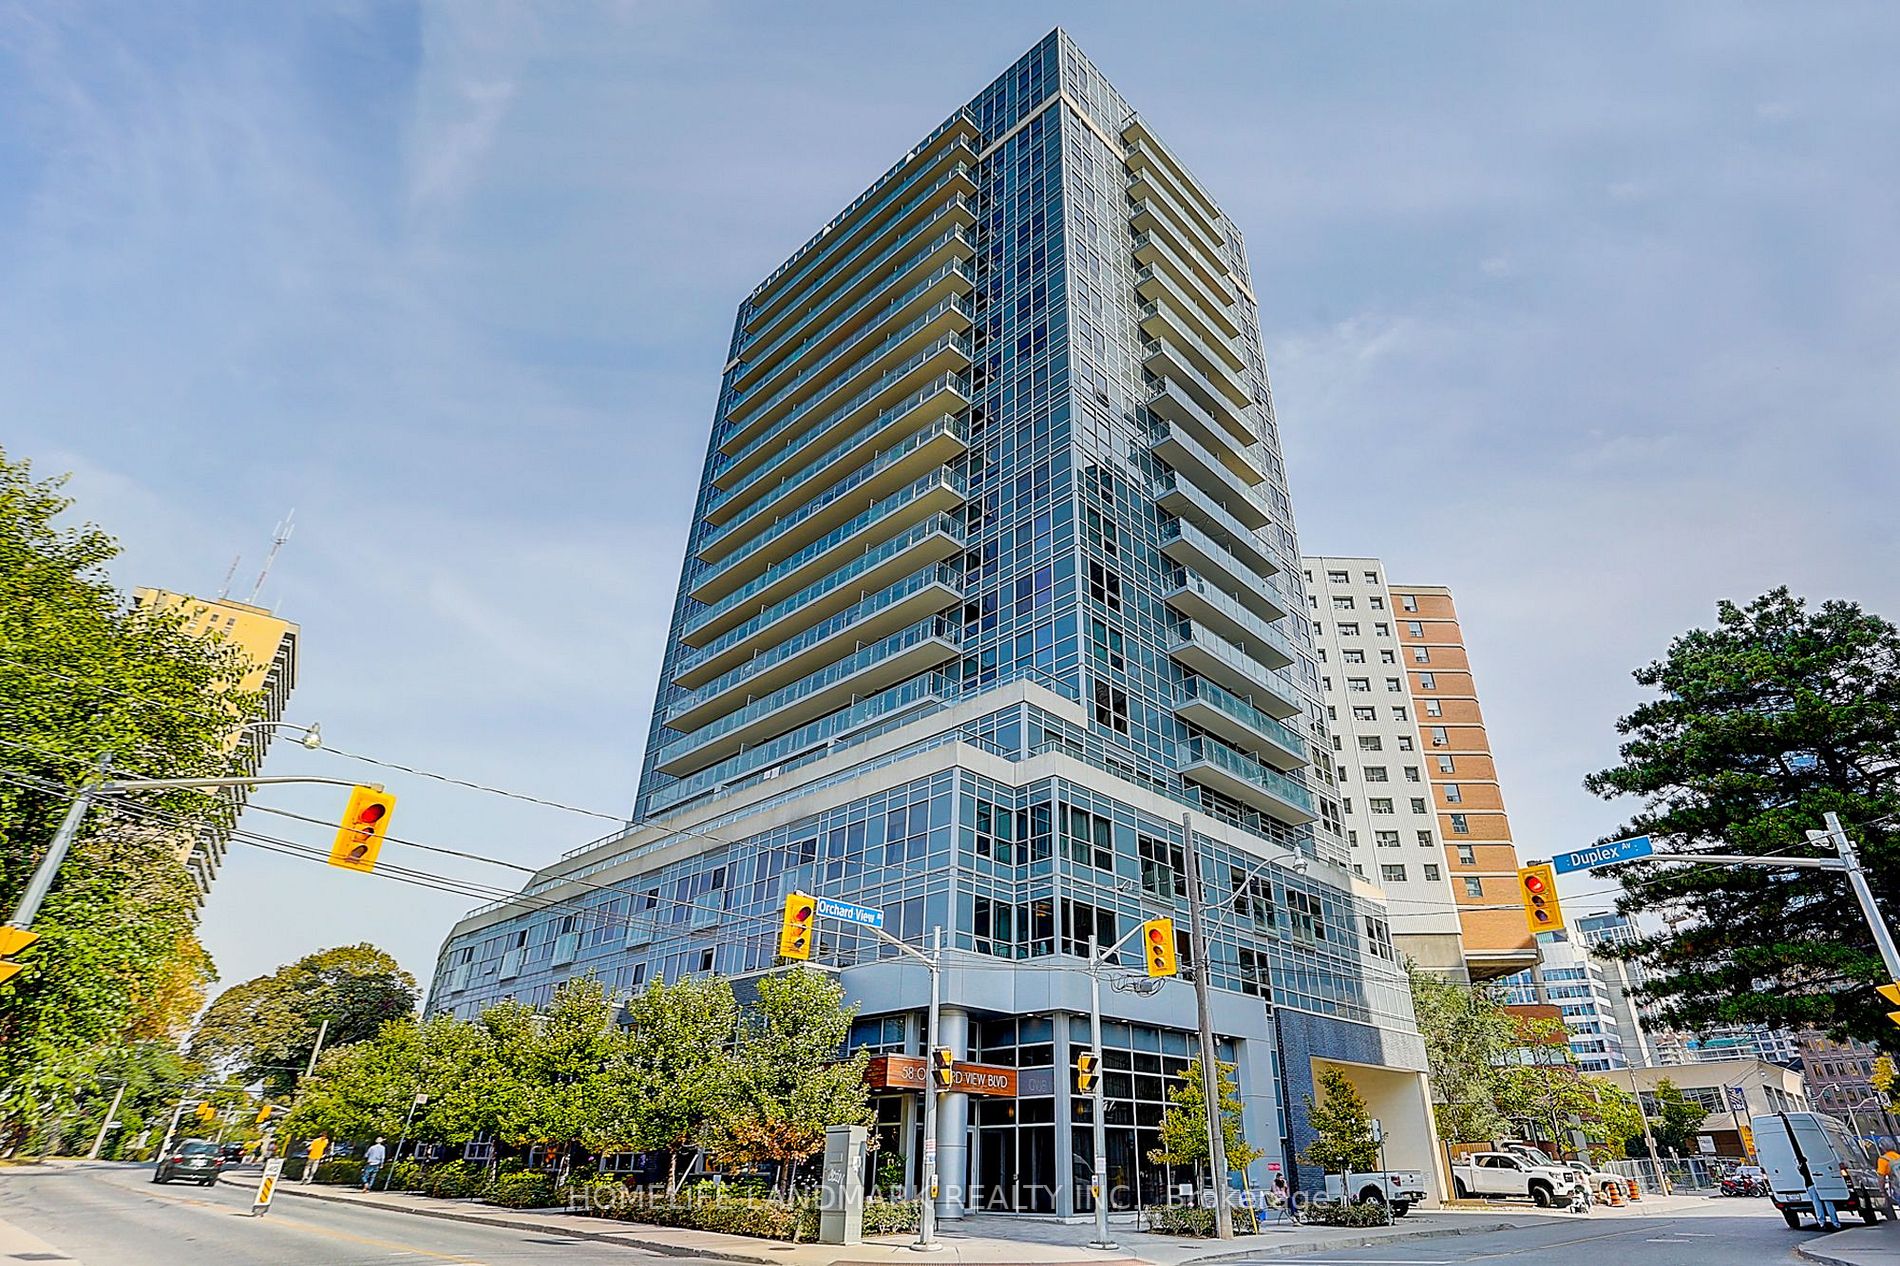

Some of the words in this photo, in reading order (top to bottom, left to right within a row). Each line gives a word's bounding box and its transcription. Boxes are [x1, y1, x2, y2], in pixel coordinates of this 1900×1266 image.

[1570, 846, 1620, 866] Duplex
[820, 900, 853, 918] Orchard
[855, 909, 875, 923] View
[901, 1066, 914, 1080] 58
[964, 1072, 986, 1086] VIEW
[987, 1075, 1008, 1088] BLVD
